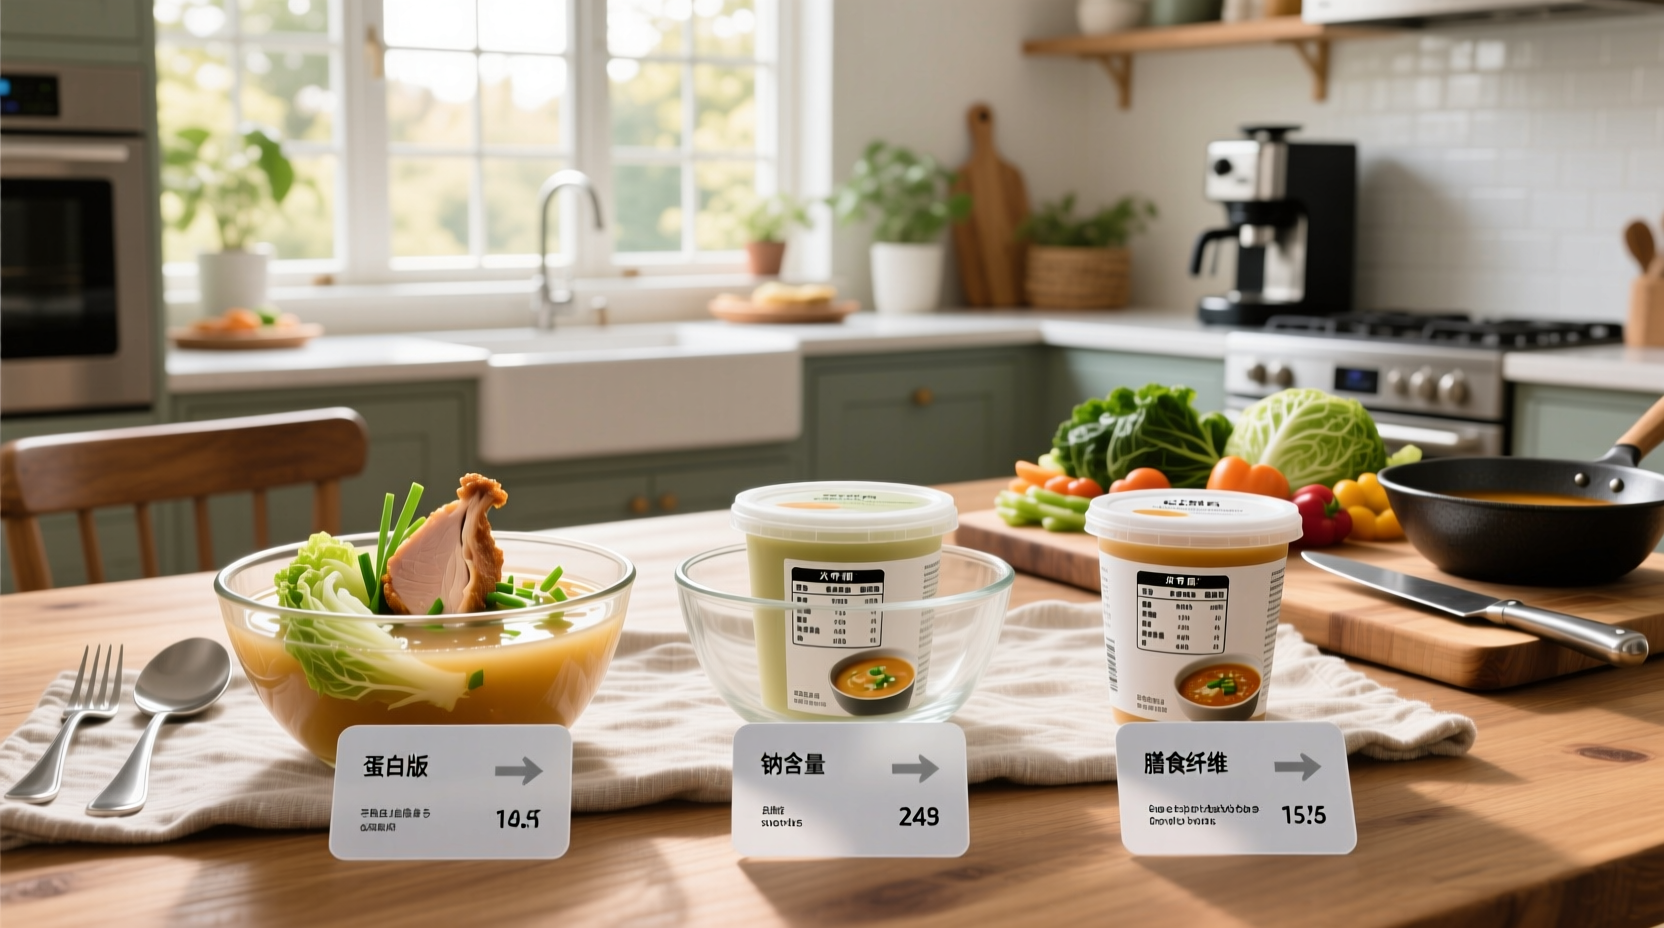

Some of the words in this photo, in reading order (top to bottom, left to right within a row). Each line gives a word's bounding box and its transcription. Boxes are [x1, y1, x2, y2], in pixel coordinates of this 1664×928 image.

[363, 754, 428, 778] 蛋白版
[761, 752, 826, 776] 钠含量
[1144, 751, 1228, 775] 膳食纤维
